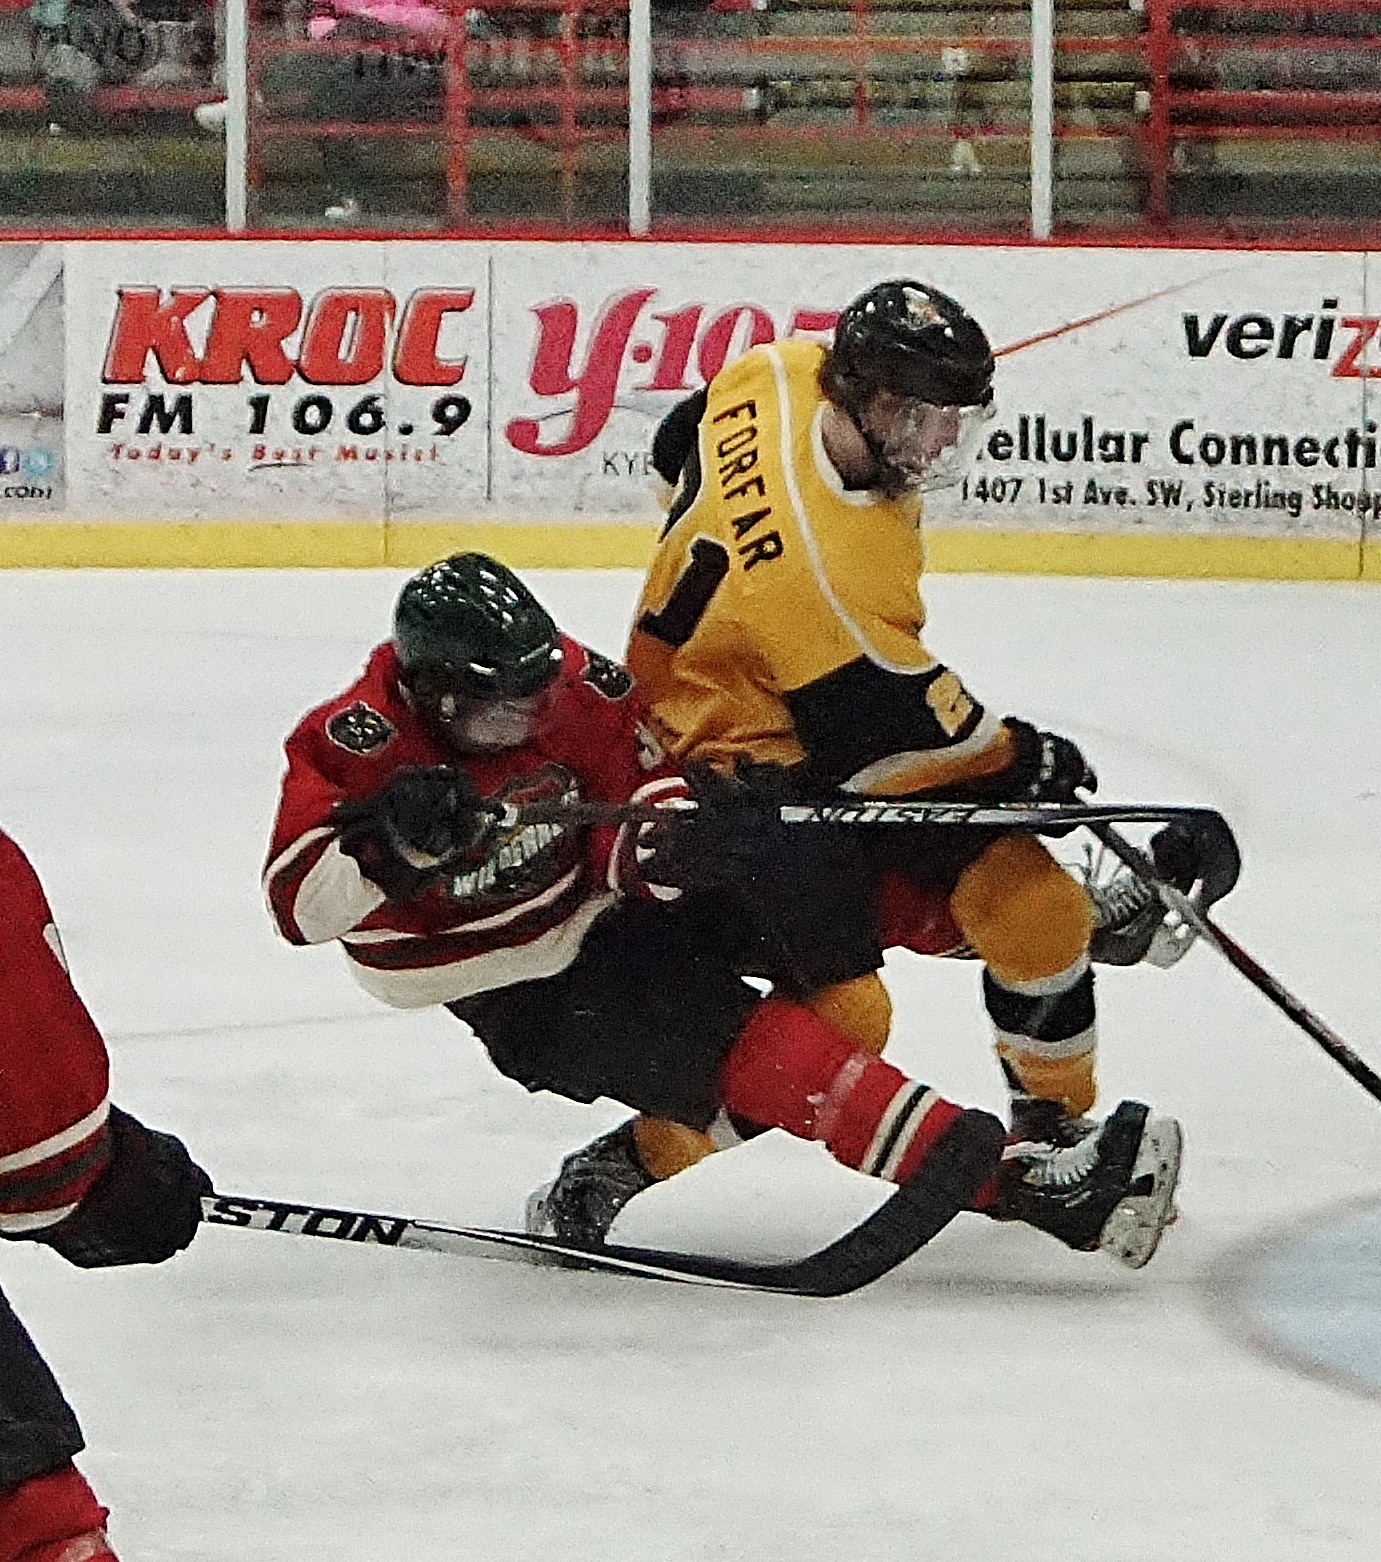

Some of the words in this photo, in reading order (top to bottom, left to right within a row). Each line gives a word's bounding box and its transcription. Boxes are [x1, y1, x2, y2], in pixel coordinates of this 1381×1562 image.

[101, 285, 475, 385] KROC
[97, 393, 193, 434] FM
[247, 393, 472, 436] 106.9
[977, 413, 1149, 463] ellular
[713, 399, 785, 571] FORFAR
[962, 477, 1023, 504] 1407
[1083, 478, 1137, 507] Ave.
[1203, 480, 1302, 518] Sterling
